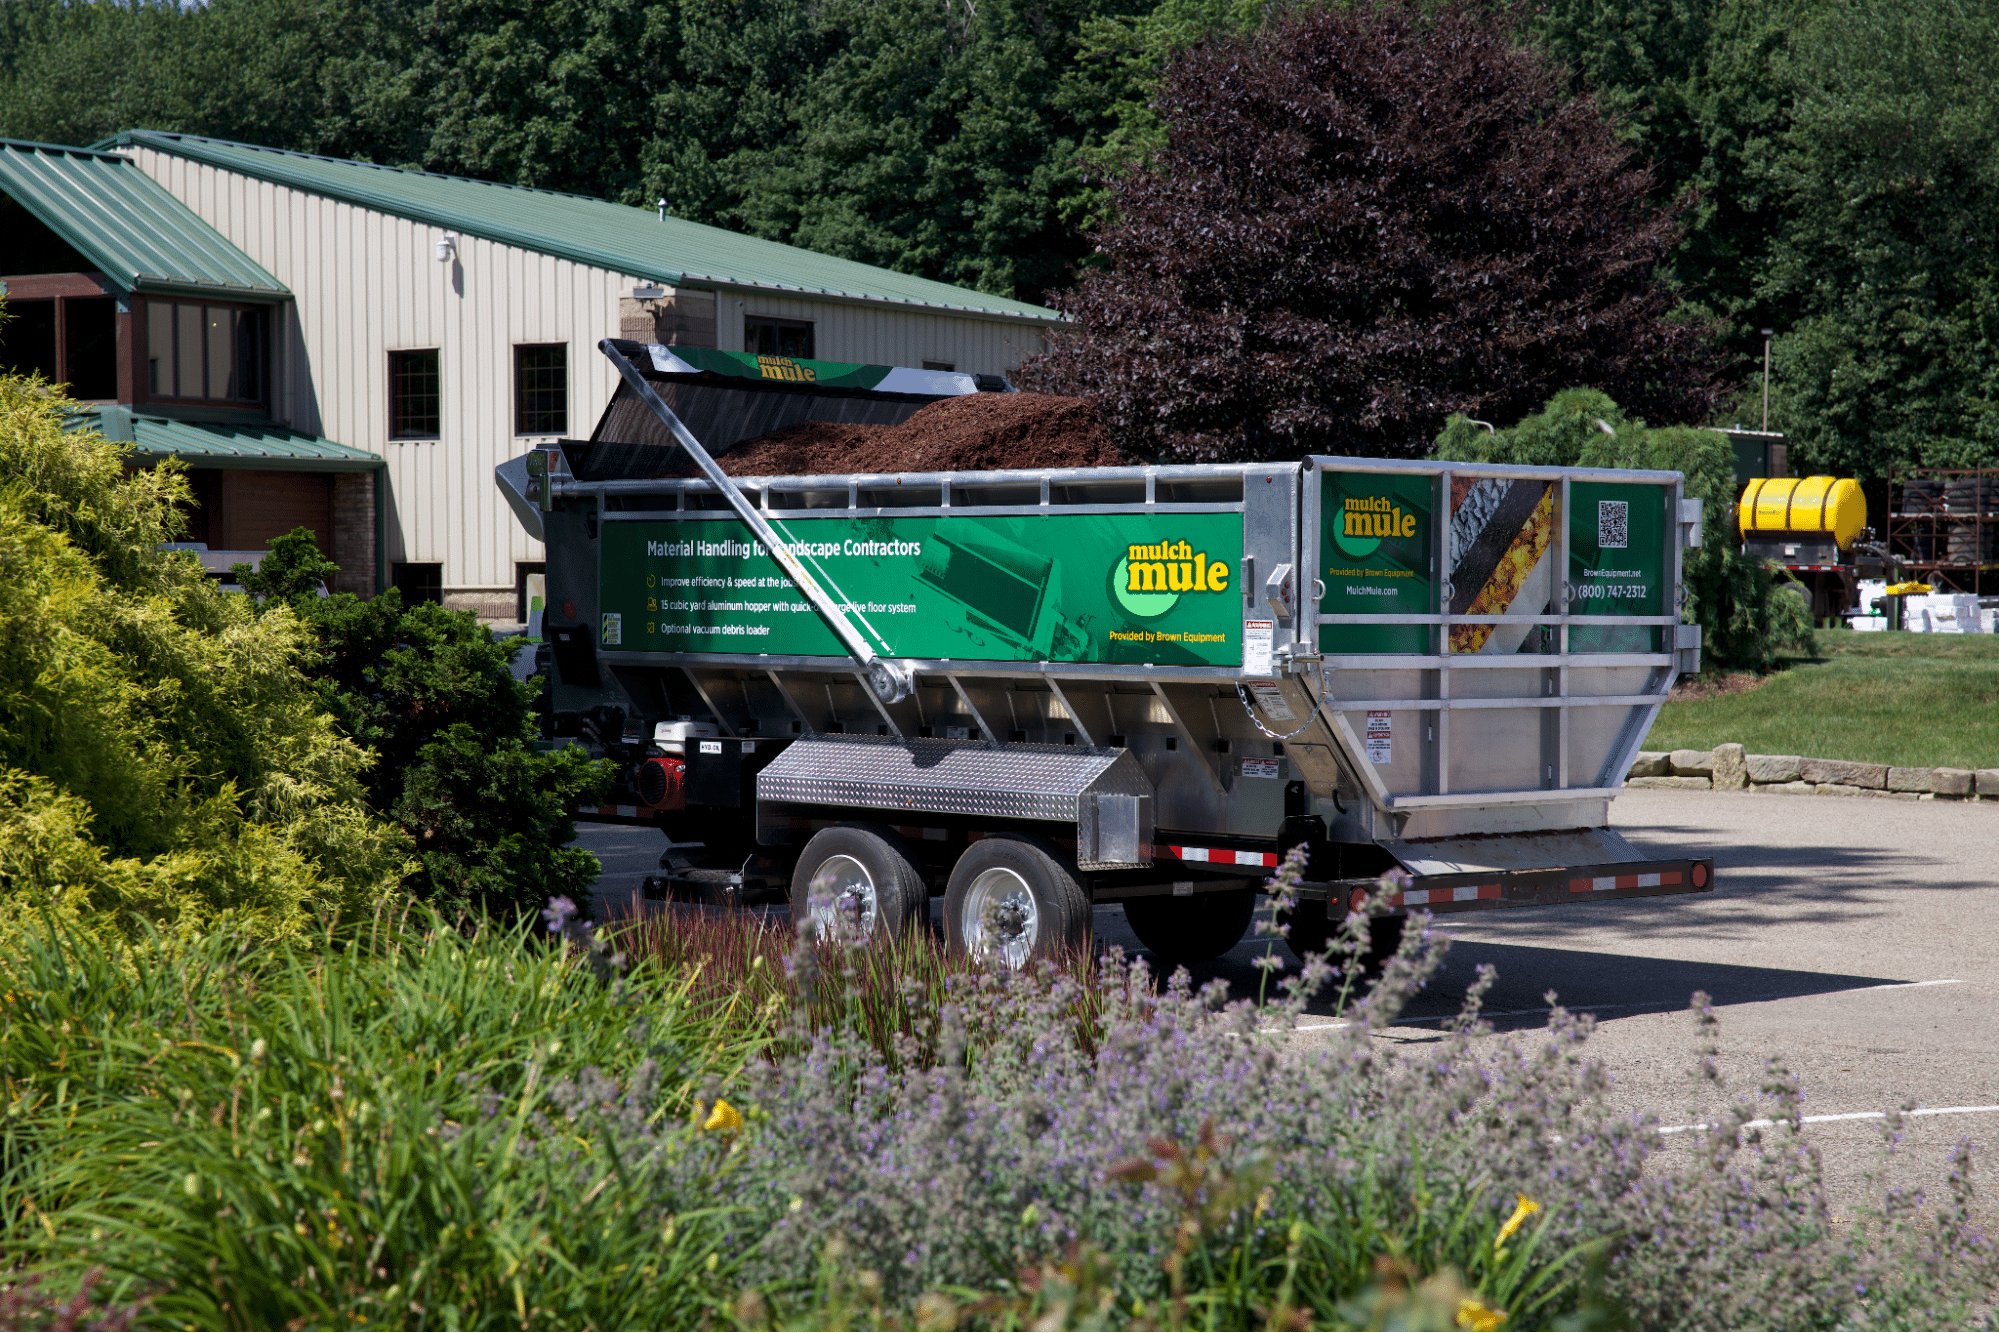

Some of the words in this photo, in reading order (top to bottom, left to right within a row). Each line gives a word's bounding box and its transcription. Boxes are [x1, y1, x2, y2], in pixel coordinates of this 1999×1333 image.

[758, 356, 793, 367] mulch
[759, 363, 816, 382] mule
[1344, 496, 1391, 512] mulch
[1344, 507, 1416, 537] mule
[647, 540, 694, 557] Material
[697, 540, 751, 559] Handling
[843, 539, 921, 556] Contractors
[1128, 540, 1193, 560] mulch
[1127, 552, 1229, 592] mule
[1329, 567, 1356, 577] Provided
[1356, 568, 1364, 578] by
[1364, 568, 1383, 577] Brown
[1384, 569, 1414, 578] Equipment
[1583, 569, 1641, 578] BrownEquipment.net
[661, 577, 690, 588] Improve
[691, 576, 726, 589] efficiency
[727, 577, 733, 587] &
[734, 577, 757, 589] speed
[757, 578, 766, 587] at
[766, 577, 780, 587] the
[1346, 585, 1398, 596] MulchMule.com
[1578, 585, 1605, 599] (800)
[1607, 585, 1647, 598] 747-2312
[661, 600, 669, 610] 15
[669, 599, 689, 610] cubic
[689, 600, 706, 612] yard
[707, 600, 743, 611] aluminum
[744, 600, 772, 613] hopper
[772, 601, 789, 612] with
[867, 601, 887, 613] floor
[888, 603, 917, 614] system
[661, 623, 691, 635] Optional
[692, 625, 721, 635] vacuum
[721, 624, 745, 635] debris
[746, 624, 770, 635] loader
[1109, 630, 1144, 642] Provided
[1145, 631, 1154, 643] by
[1156, 631, 1182, 642] Brown
[1183, 631, 1226, 643] Equipment
